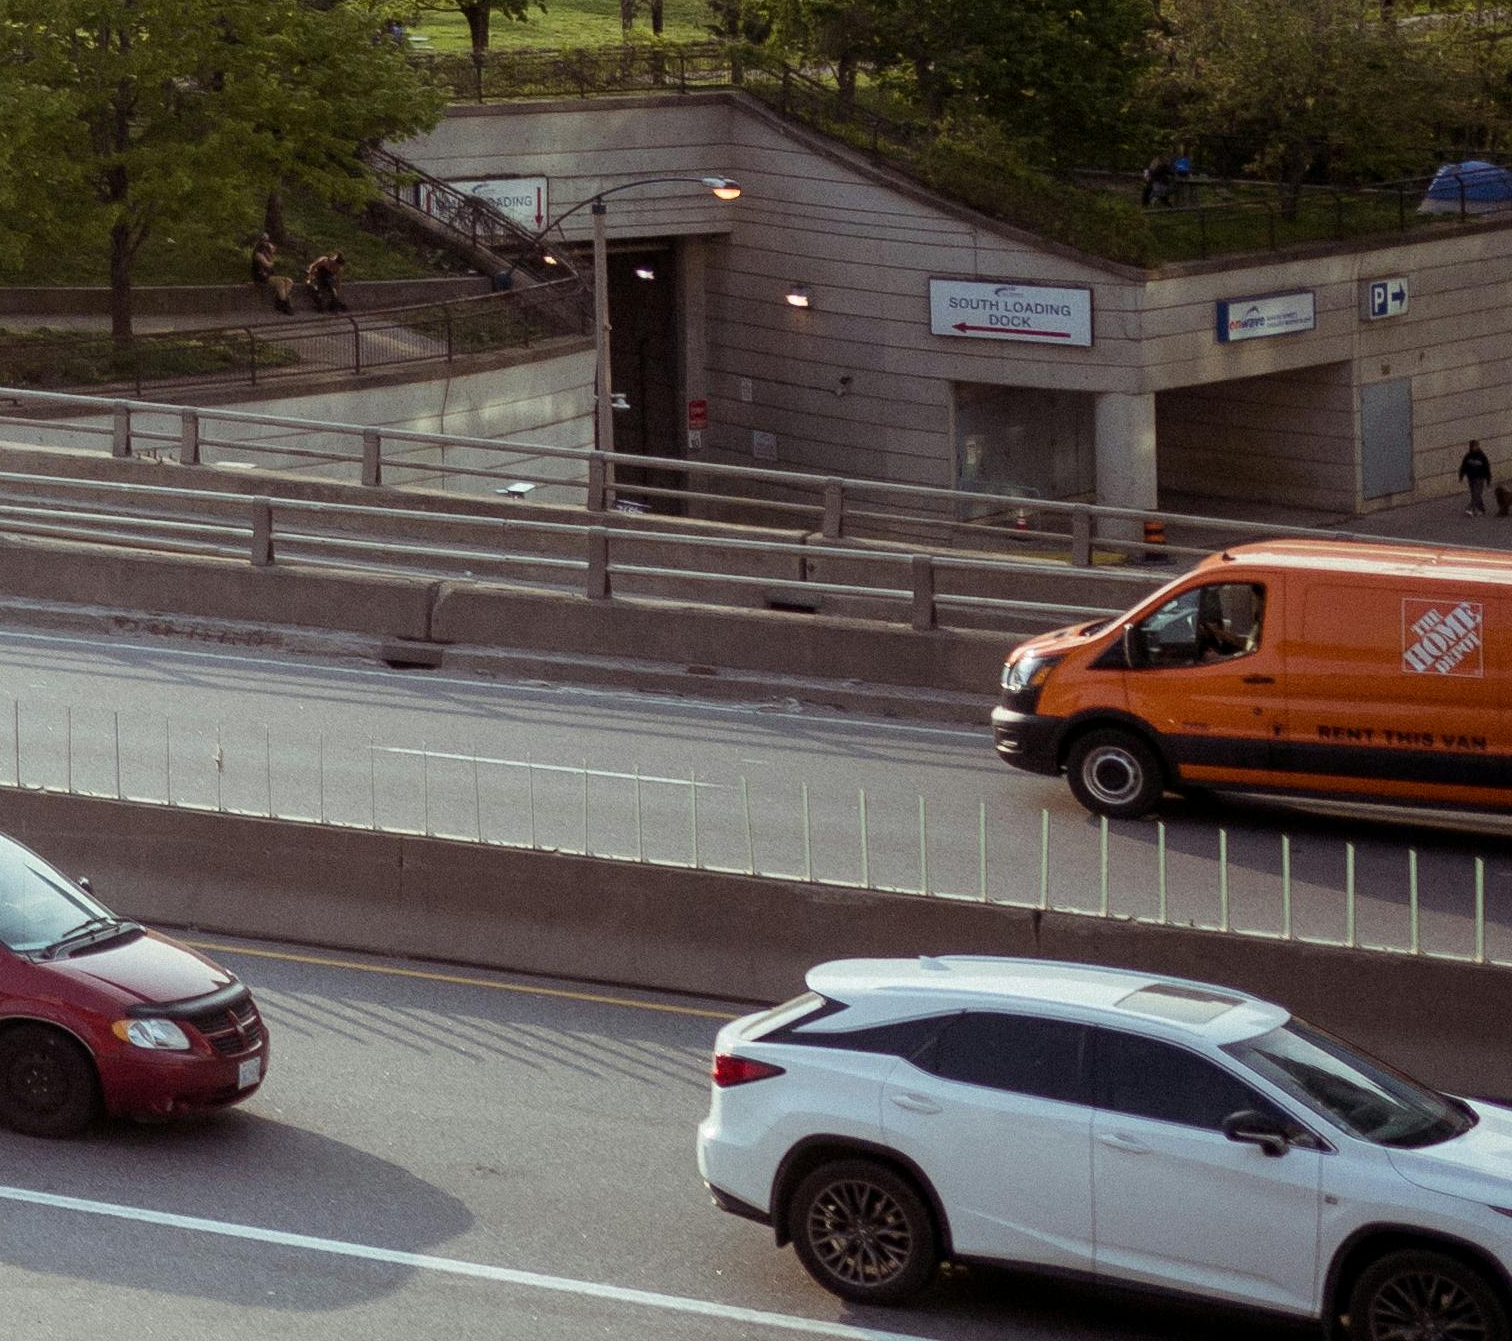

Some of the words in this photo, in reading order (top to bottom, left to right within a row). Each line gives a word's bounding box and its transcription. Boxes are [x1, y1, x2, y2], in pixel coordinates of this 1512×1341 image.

[949, 297, 1000, 312] SOUTH
[1005, 301, 1072, 317] LOADING
[1373, 287, 1385, 313] P
[989, 314, 1032, 328] DOCK
[1409, 608, 1444, 637] THE
[1403, 601, 1482, 673] HOME
[1434, 630, 1482, 674] DEPOT
[1318, 725, 1374, 741] RENT
[1384, 728, 1434, 747] THIS
[1442, 733, 1487, 750] VAN
